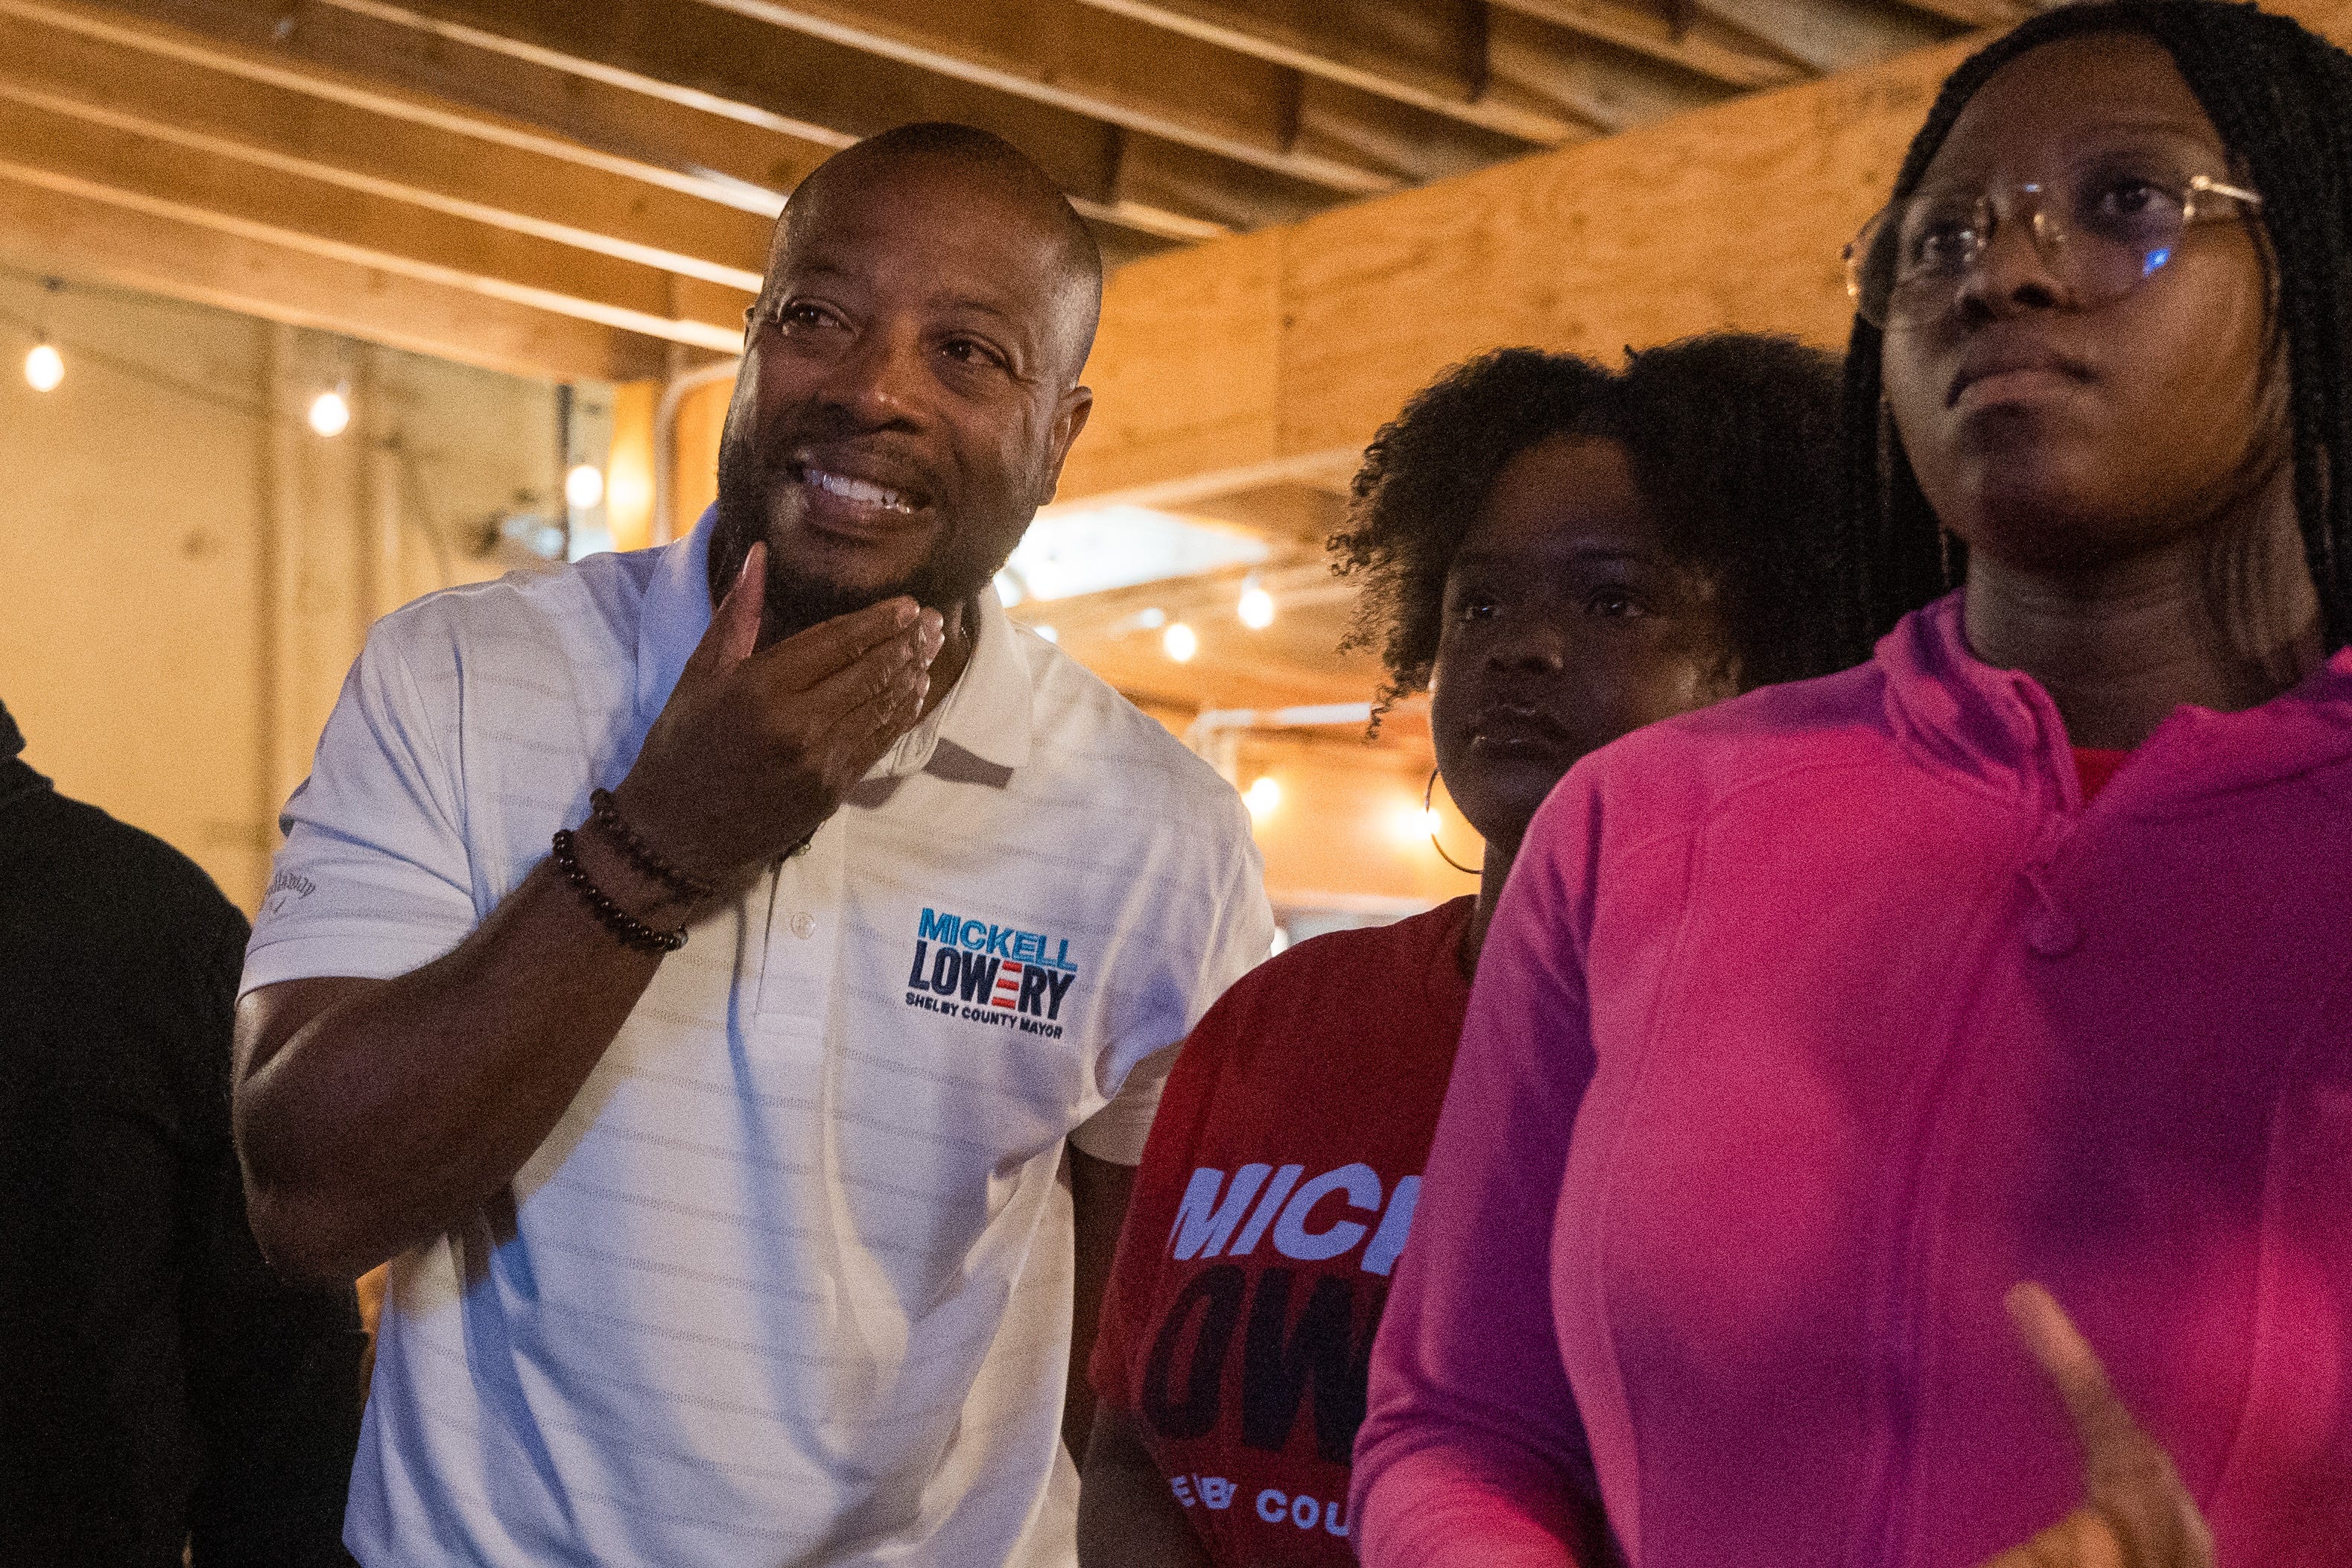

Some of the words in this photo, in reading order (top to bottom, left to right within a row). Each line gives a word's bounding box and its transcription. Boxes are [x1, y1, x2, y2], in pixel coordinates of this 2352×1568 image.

[918, 907, 1078, 972] MICKELL
[908, 939, 1076, 1021] LOWERY
[905, 991, 960, 1018] SHELBY
[961, 1006, 1018, 1029] COUNTY
[1019, 1016, 1063, 1039] MAYOR
